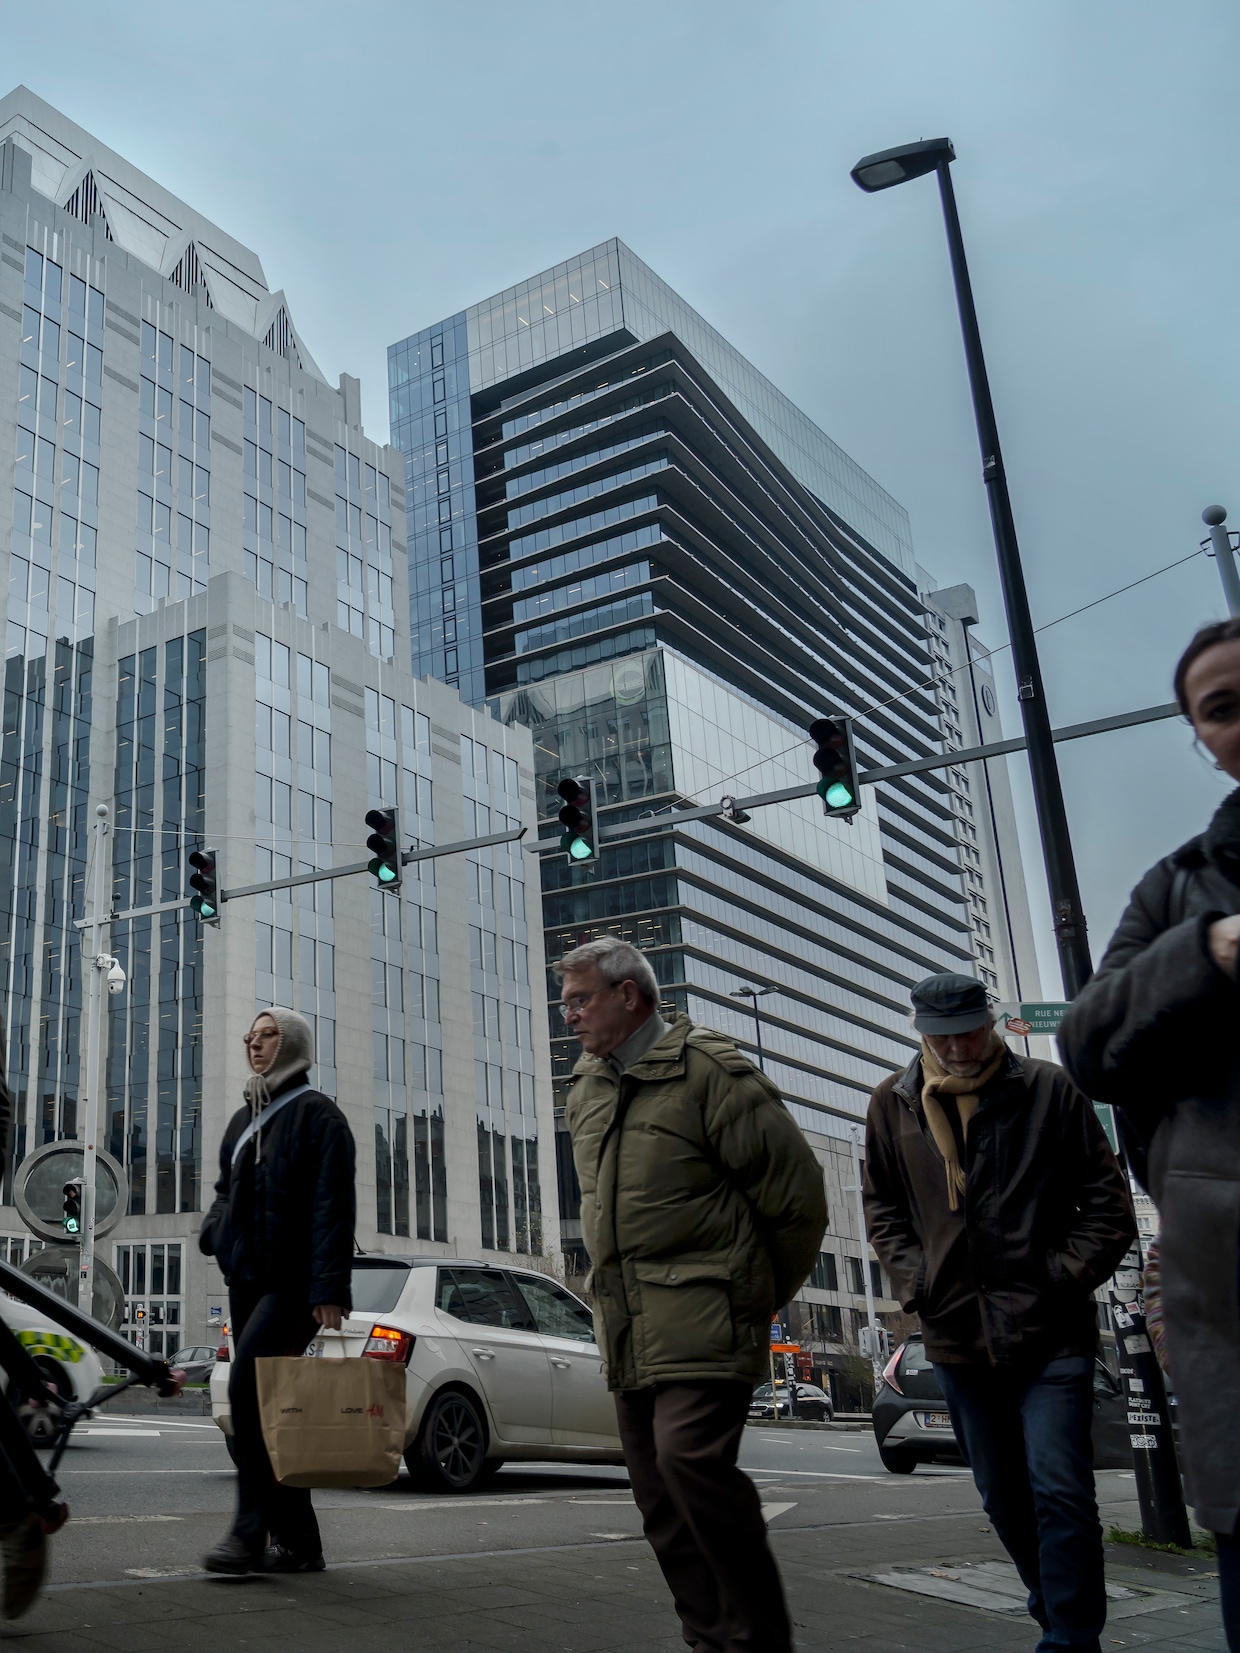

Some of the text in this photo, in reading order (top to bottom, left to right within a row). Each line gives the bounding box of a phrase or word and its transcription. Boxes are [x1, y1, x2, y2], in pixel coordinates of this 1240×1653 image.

[1035, 1009, 1067, 1017] RUE NE
[280, 1407, 303, 1415] WITH
